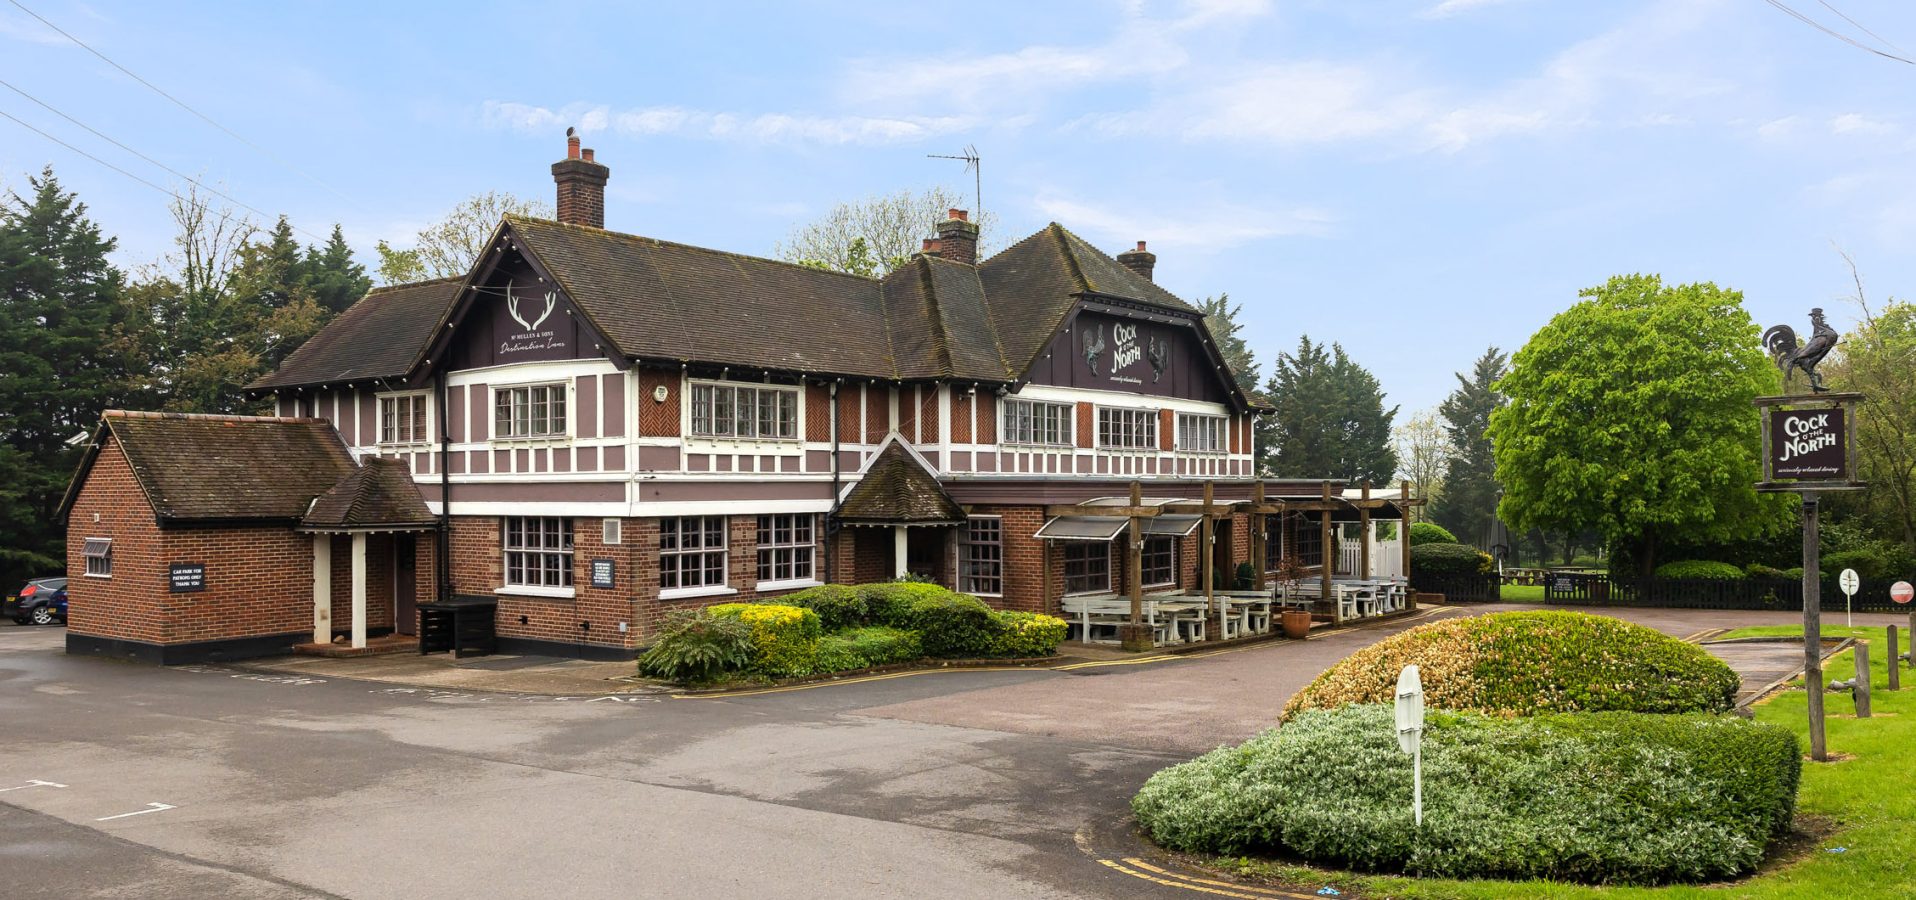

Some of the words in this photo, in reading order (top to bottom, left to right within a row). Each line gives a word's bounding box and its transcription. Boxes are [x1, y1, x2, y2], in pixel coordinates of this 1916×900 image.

[1114, 323, 1136, 346] COCK
[1111, 346, 1140, 373] NORTH
[1784, 414, 1829, 437] COCK
[1779, 433, 1836, 462] NORTH
